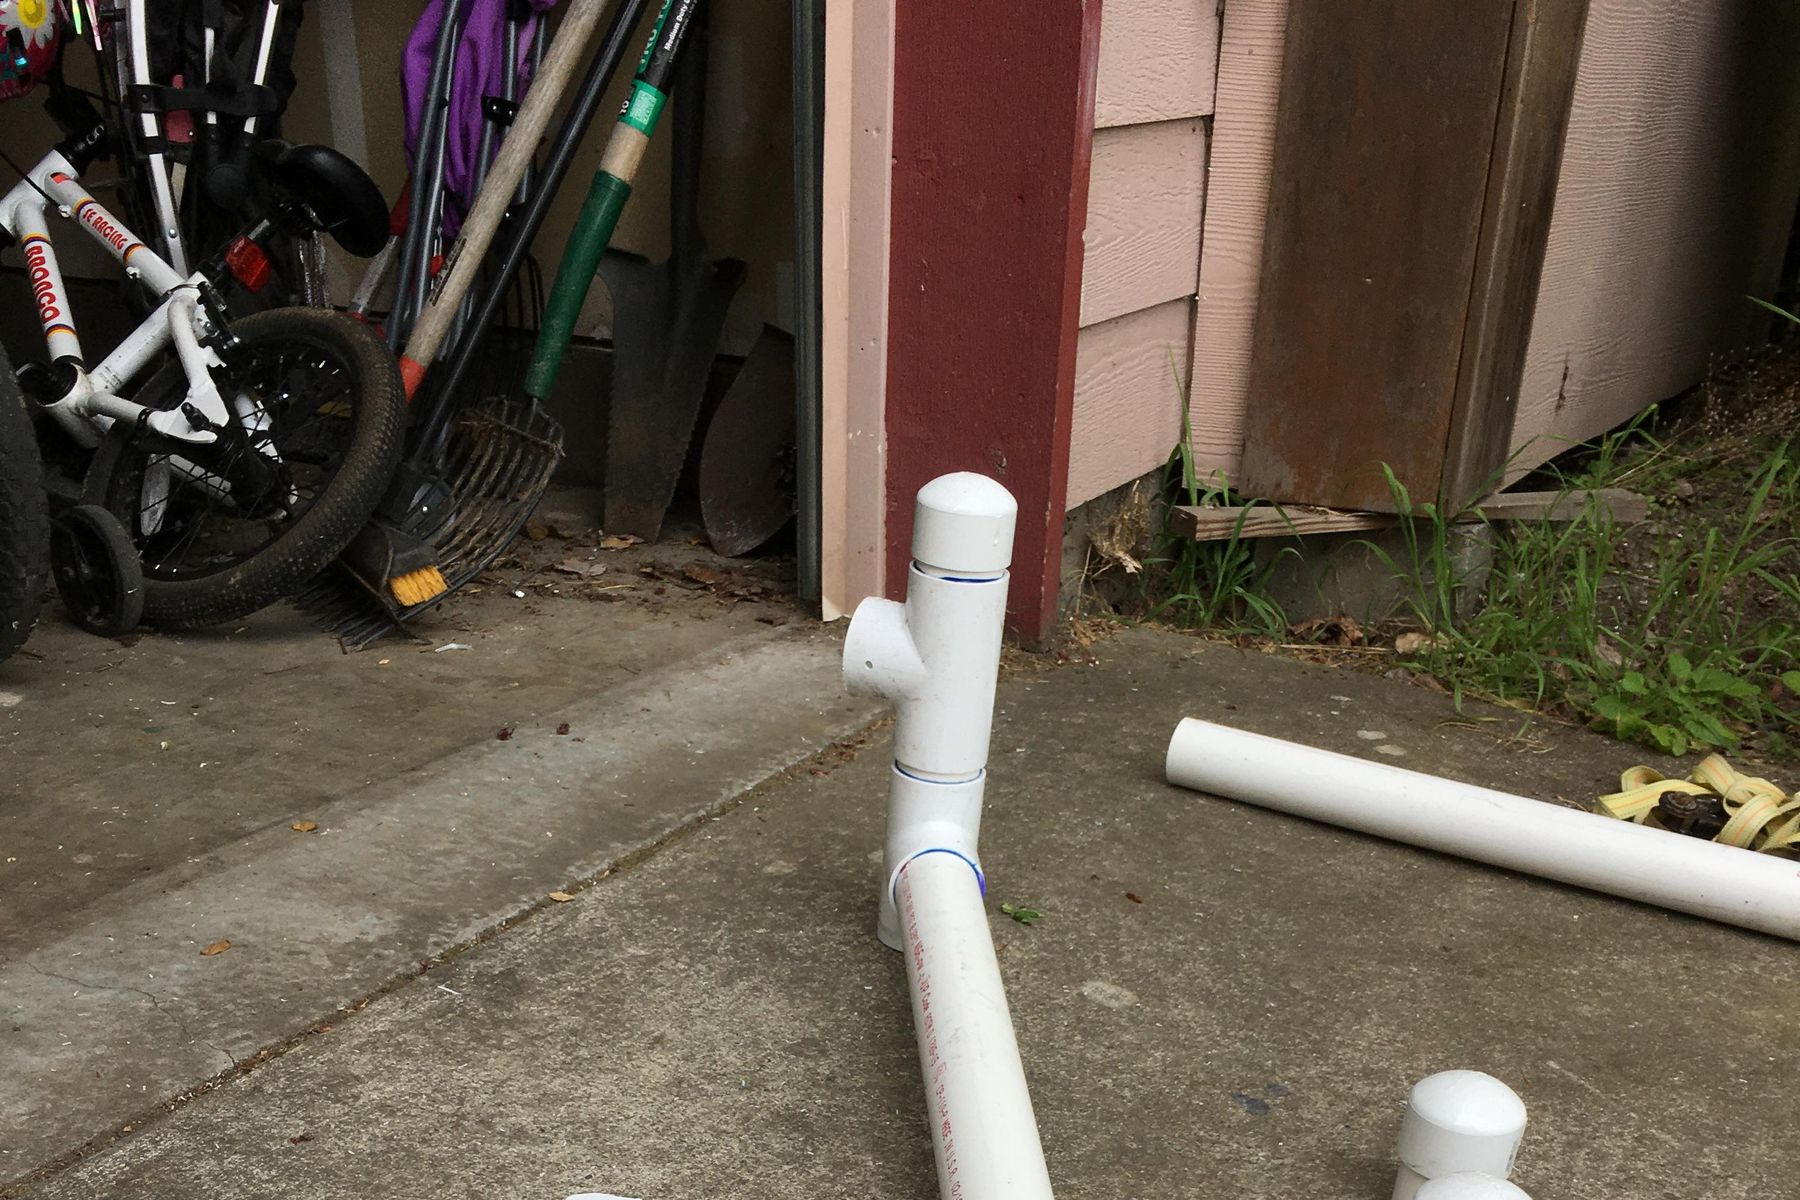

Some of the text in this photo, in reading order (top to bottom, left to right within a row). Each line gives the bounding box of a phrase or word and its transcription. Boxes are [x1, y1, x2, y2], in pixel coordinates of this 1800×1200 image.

[664, 22, 680, 51] Medium
[676, 4, 688, 22] Duty
[83, 208, 129, 250] SE RACING
[24, 245, 60, 324] BRONCO
